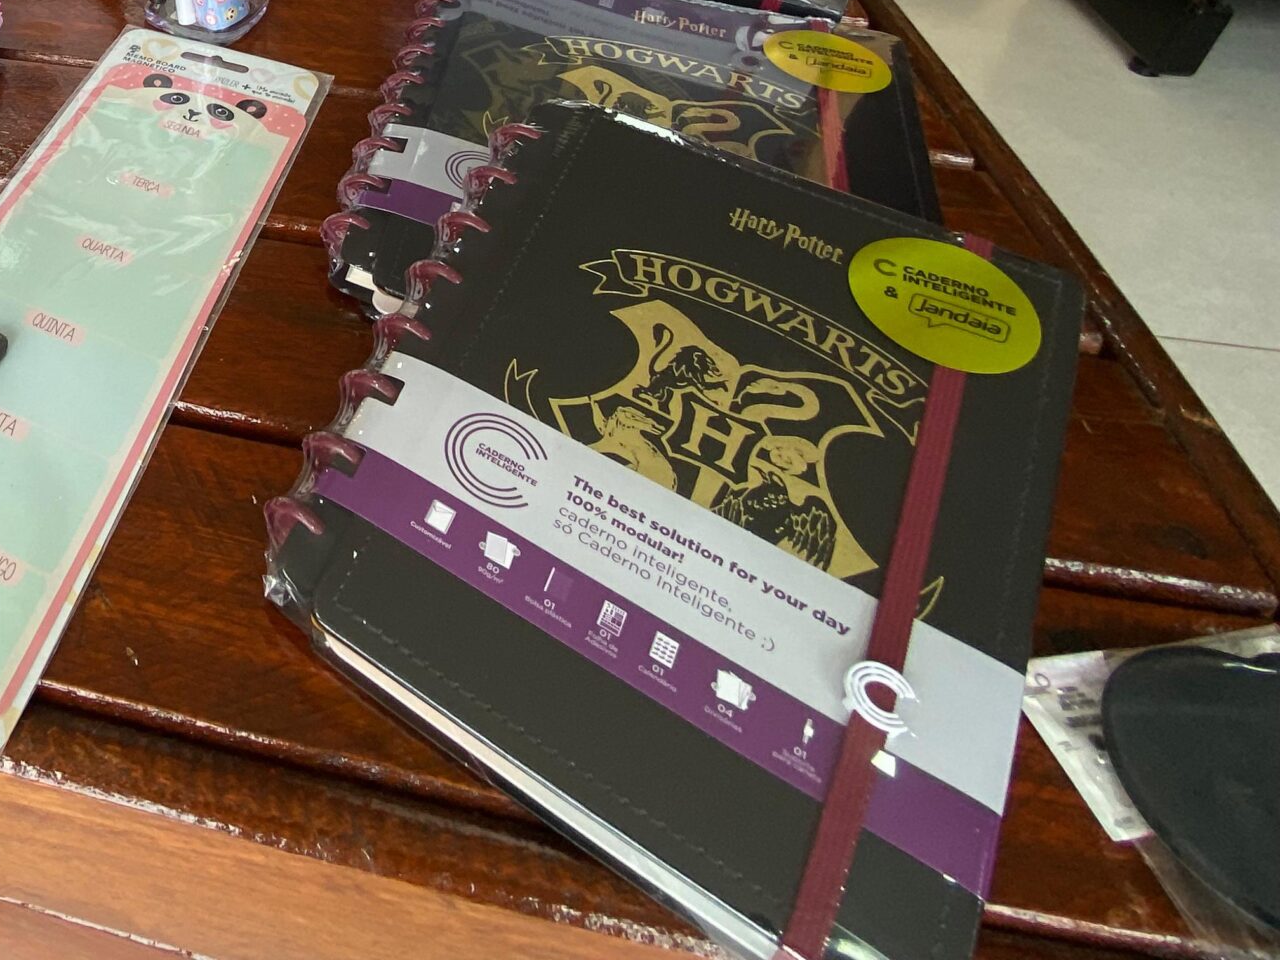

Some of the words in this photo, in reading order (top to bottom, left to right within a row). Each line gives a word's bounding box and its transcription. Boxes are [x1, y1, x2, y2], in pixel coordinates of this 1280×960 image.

[633, 9, 676, 28] Harry
[678, 16, 727, 37] Potter
[126, 52, 155, 64] MEMO
[156, 58, 186, 72] BOARD
[562, 38, 807, 109] HOGWARTS
[163, 120, 201, 137] SEGUNDA
[132, 175, 160, 193] TERÇA
[81, 238, 124, 262] QUARTA
[728, 207, 784, 241] Harry
[783, 223, 844, 265] Potter
[902, 274, 1017, 317] INTELIGENTE
[903, 265, 989, 298] CADERNO
[629, 253, 916, 397] HOGWARTS
[883, 286, 899, 300] &
[914, 298, 1002, 335] Jandaia
[32, 312, 76, 342] QUINTA
[684, 401, 755, 473] H
[475, 447, 538, 487] INTELIGENTE
[477, 442, 526, 473] CADERNO
[565, 490, 608, 521] 100%
[609, 519, 686, 564] modular!
[557, 507, 628, 551] caderno
[630, 543, 734, 613] inteligente,
[572, 475, 605, 501] The
[606, 492, 648, 522] best
[649, 517, 725, 567] solution
[728, 559, 759, 586] for
[760, 579, 810, 613] your
[811, 607, 852, 638] day
[553, 519, 574, 535] só
[577, 531, 652, 581] Caderno
[655, 575, 758, 642] Inteligente
[543, 598, 555, 610] 01
[599, 629, 611, 640] 01
[652, 664, 664, 676] 01
[717, 703, 733, 718] 04
[793, 746, 807, 759] 01
